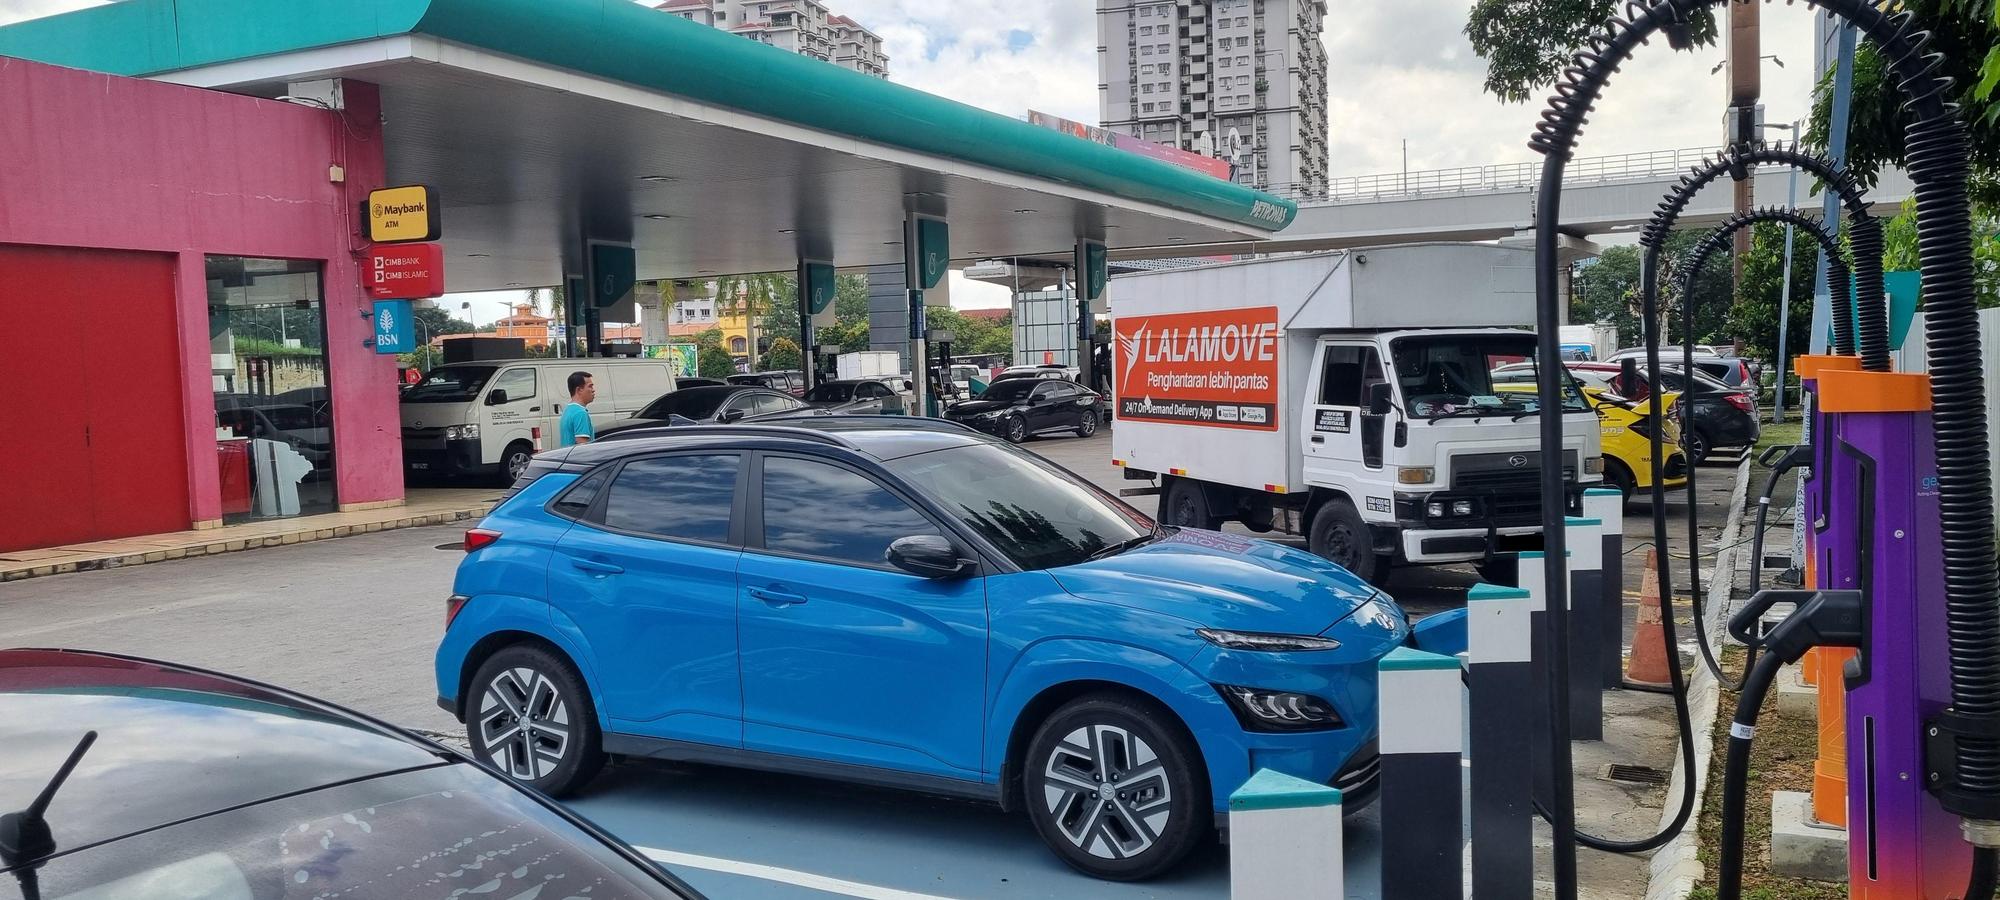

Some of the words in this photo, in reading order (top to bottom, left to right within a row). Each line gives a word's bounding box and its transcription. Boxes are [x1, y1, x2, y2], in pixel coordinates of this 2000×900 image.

[384, 202, 425, 216] Maybank
[1250, 200, 1287, 223] PETRONAS
[402, 257, 420, 265] BANK
[402, 270, 429, 279] ISLAMIC
[378, 333, 398, 346] BSN
[1145, 322, 1276, 362] LALAMOVE
[1147, 371, 1207, 391] Penghantaran
[1208, 371, 1233, 389] lebih
[1233, 372, 1269, 393] pantas
[1125, 401, 1138, 414] 24/7
[1174, 404, 1199, 419] Delivery
[1199, 406, 1213, 420] App
